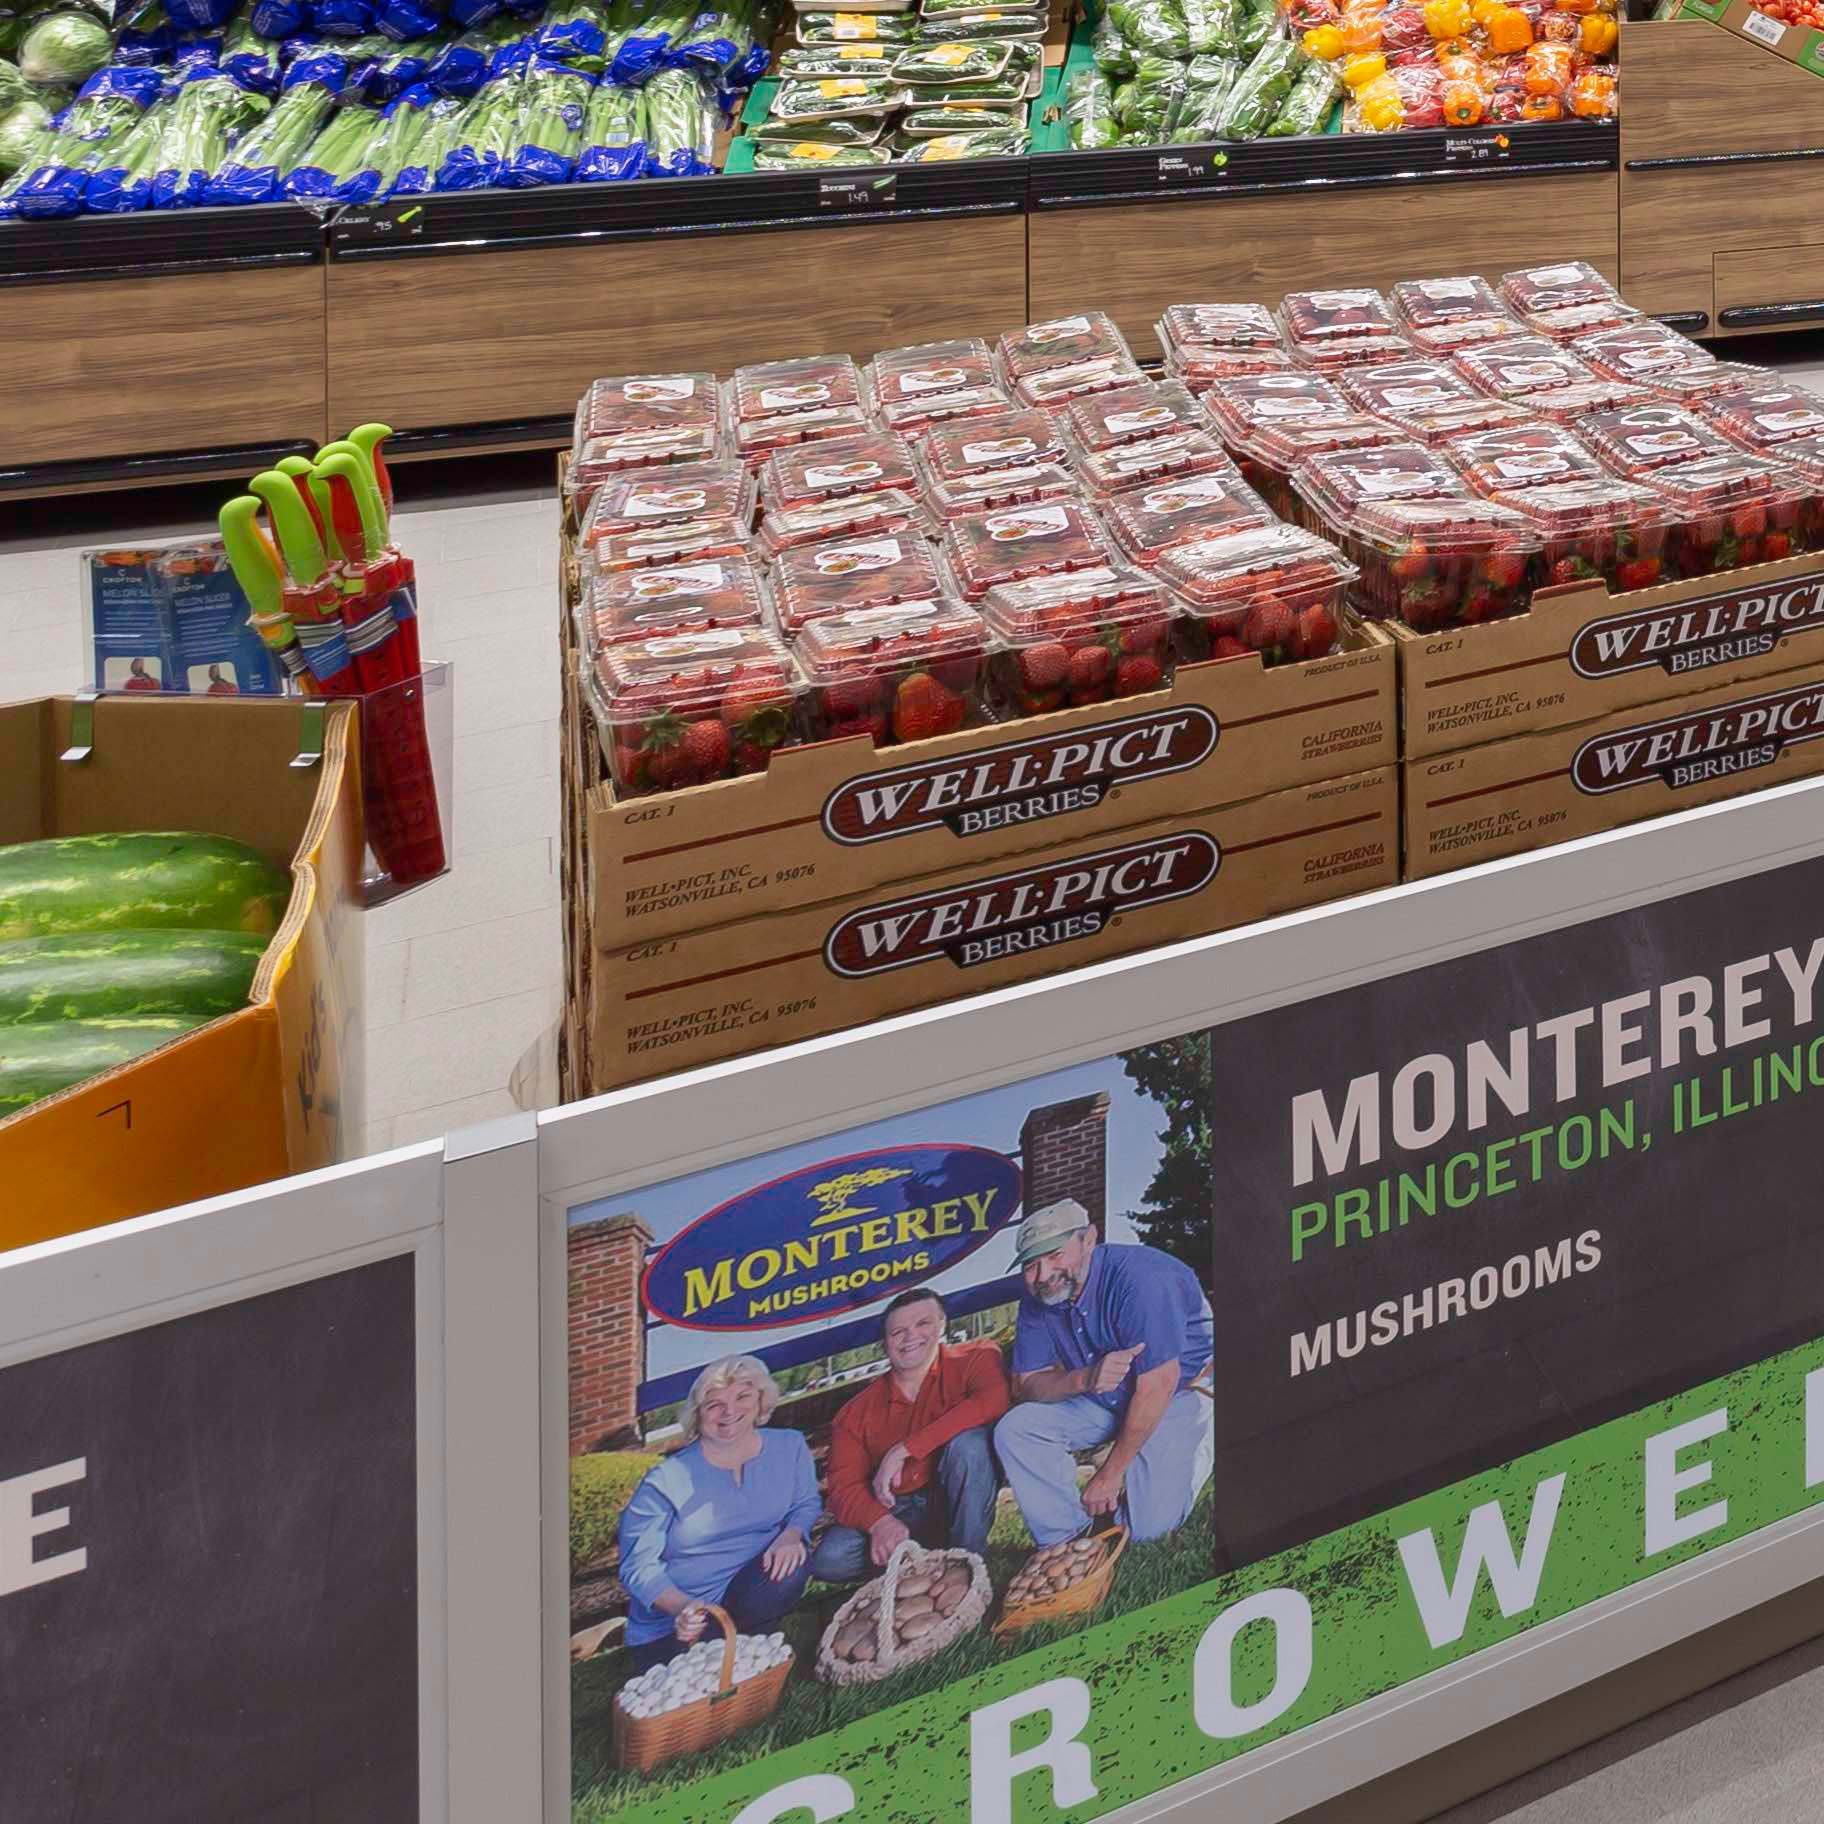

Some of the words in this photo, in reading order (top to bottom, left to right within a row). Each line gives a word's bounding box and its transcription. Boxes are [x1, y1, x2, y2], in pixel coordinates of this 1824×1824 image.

[1425, 640, 1453, 655] CAT.
[1671, 633, 1775, 675] BERRIES
[1427, 706, 1514, 735] WATSONVILLE,
[1515, 701, 1532, 714] CA
[1536, 692, 1566, 709] 95076
[1495, 691, 1520, 704] INC.
[1301, 721, 1384, 749] CALIFORNIA
[1301, 734, 1384, 762] STRAWBERRIES
[1427, 761, 1456, 777] CAT.
[1671, 743, 1777, 787] BERRIES
[624, 807, 661, 825] CAT.
[959, 782, 1102, 836] BERRIES
[1497, 809, 1522, 824] INC.
[1428, 824, 1516, 856] WATSONVILLE,
[1517, 819, 1533, 832] CA
[1537, 809, 1568, 826] 95076
[719, 863, 752, 881] INC.
[1303, 842, 1385, 874] CALIFORNIA
[1303, 855, 1385, 885] STRAWBERRIES
[625, 882, 743, 918] WATSONVILLE,
[747, 876, 768, 890] CA
[775, 863, 816, 884] 95076
[626, 944, 664, 962] CAT.
[961, 911, 1103, 967] BERRIES
[627, 1017, 744, 1056] WATSONVILLE,
[748, 1010, 769, 1025] CA
[776, 995, 817, 1017] 95076
[720, 998, 754, 1016] INC.
[1290, 1098, 1653, 1264] PRINCETON,
[682, 1187, 999, 1319] MONTEREY
[747, 1250, 930, 1319] MUSHROOMS
[1290, 1229, 1603, 1378] MUSHROOMS
